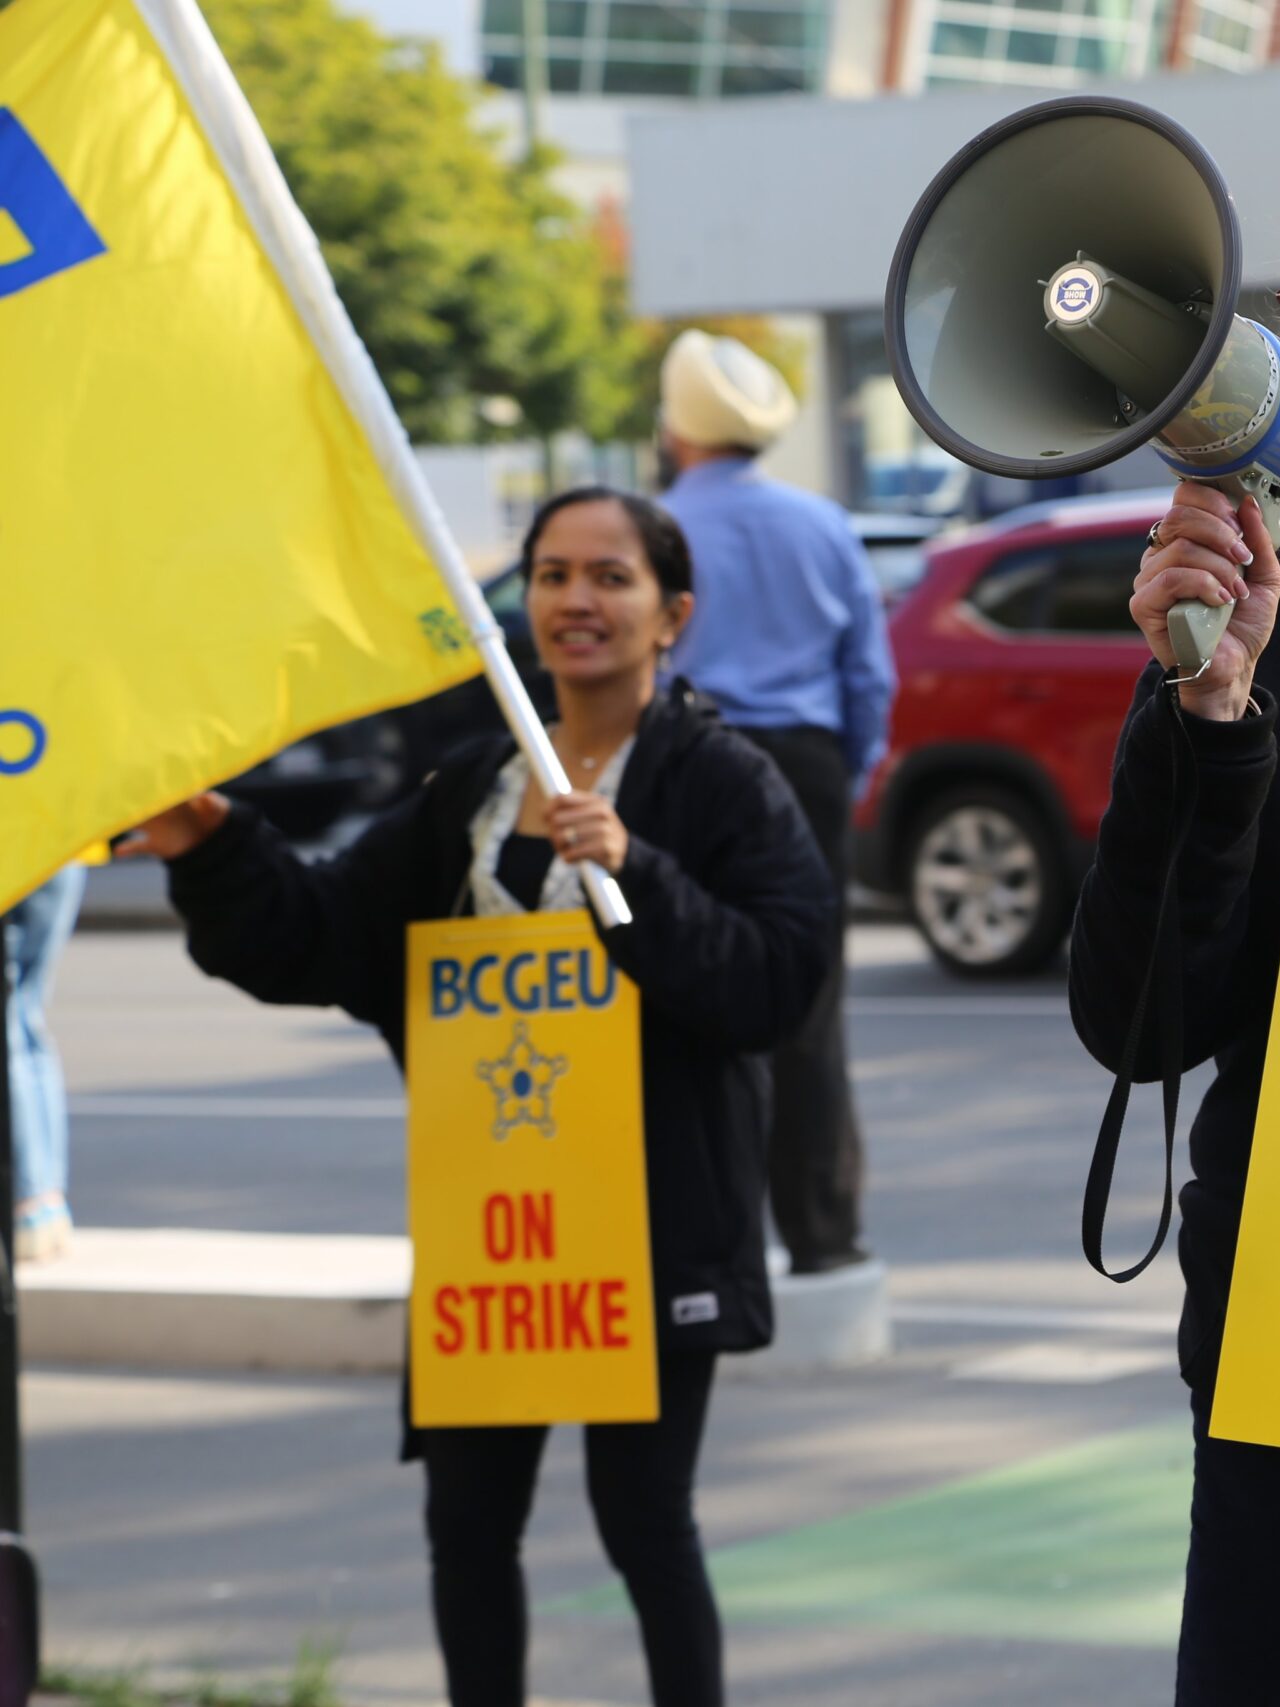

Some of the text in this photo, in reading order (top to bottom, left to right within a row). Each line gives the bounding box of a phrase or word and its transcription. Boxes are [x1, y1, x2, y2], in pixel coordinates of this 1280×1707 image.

[432, 948, 617, 1017] BCGEU
[484, 1191, 556, 1264] ON
[433, 1279, 630, 1356] STRIKE
